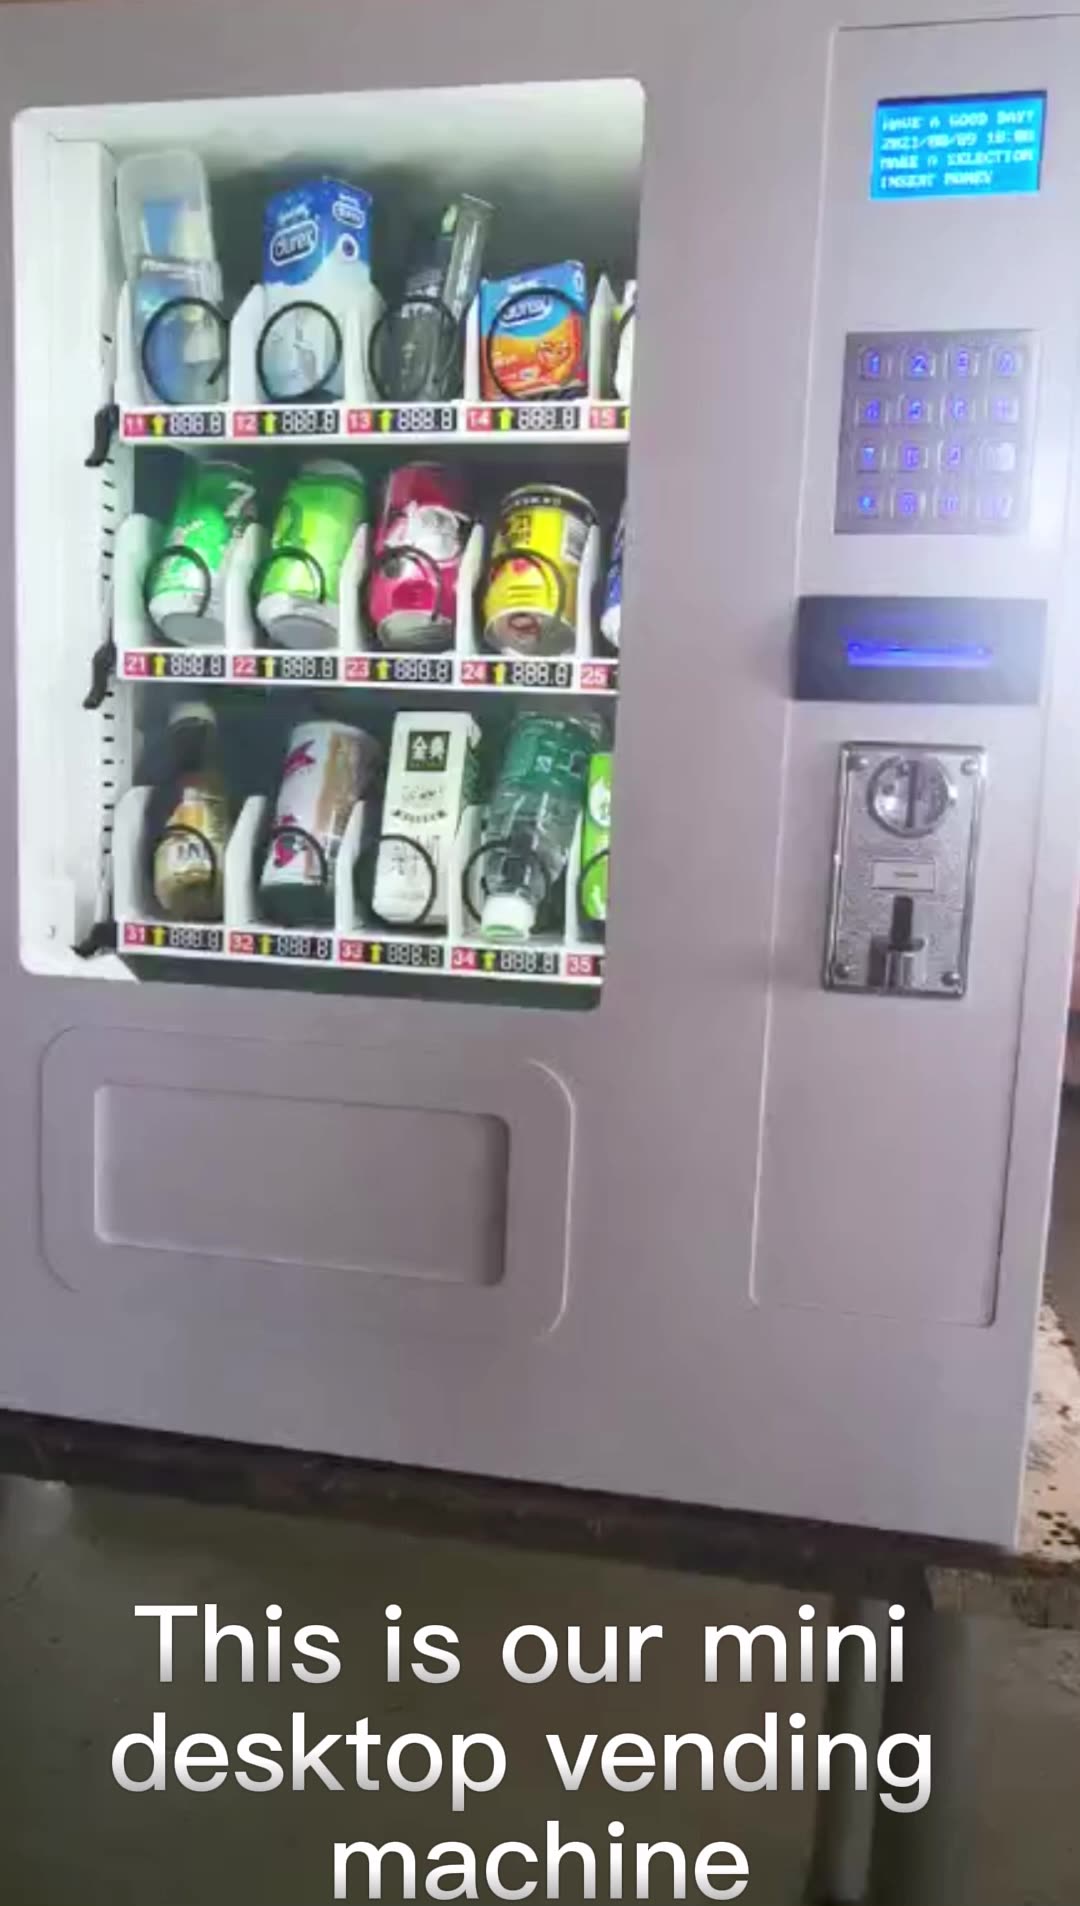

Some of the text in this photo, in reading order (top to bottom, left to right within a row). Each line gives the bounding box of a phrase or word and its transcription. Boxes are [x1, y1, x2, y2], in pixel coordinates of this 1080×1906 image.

[126, 415, 145, 433] 11
[236, 413, 257, 431] 12
[350, 412, 370, 429] 13
[469, 409, 490, 427] 14
[592, 409, 614, 428] 15
[126, 655, 146, 673] 21
[235, 658, 256, 675] 22
[349, 661, 369, 677] 23
[462, 663, 485, 681] 24
[583, 667, 606, 684] 25
[126, 925, 145, 942] 31
[233, 934, 253, 951] 32
[341, 942, 363, 959] 33
[453, 949, 475, 966] 34
[568, 956, 592, 973] 35
